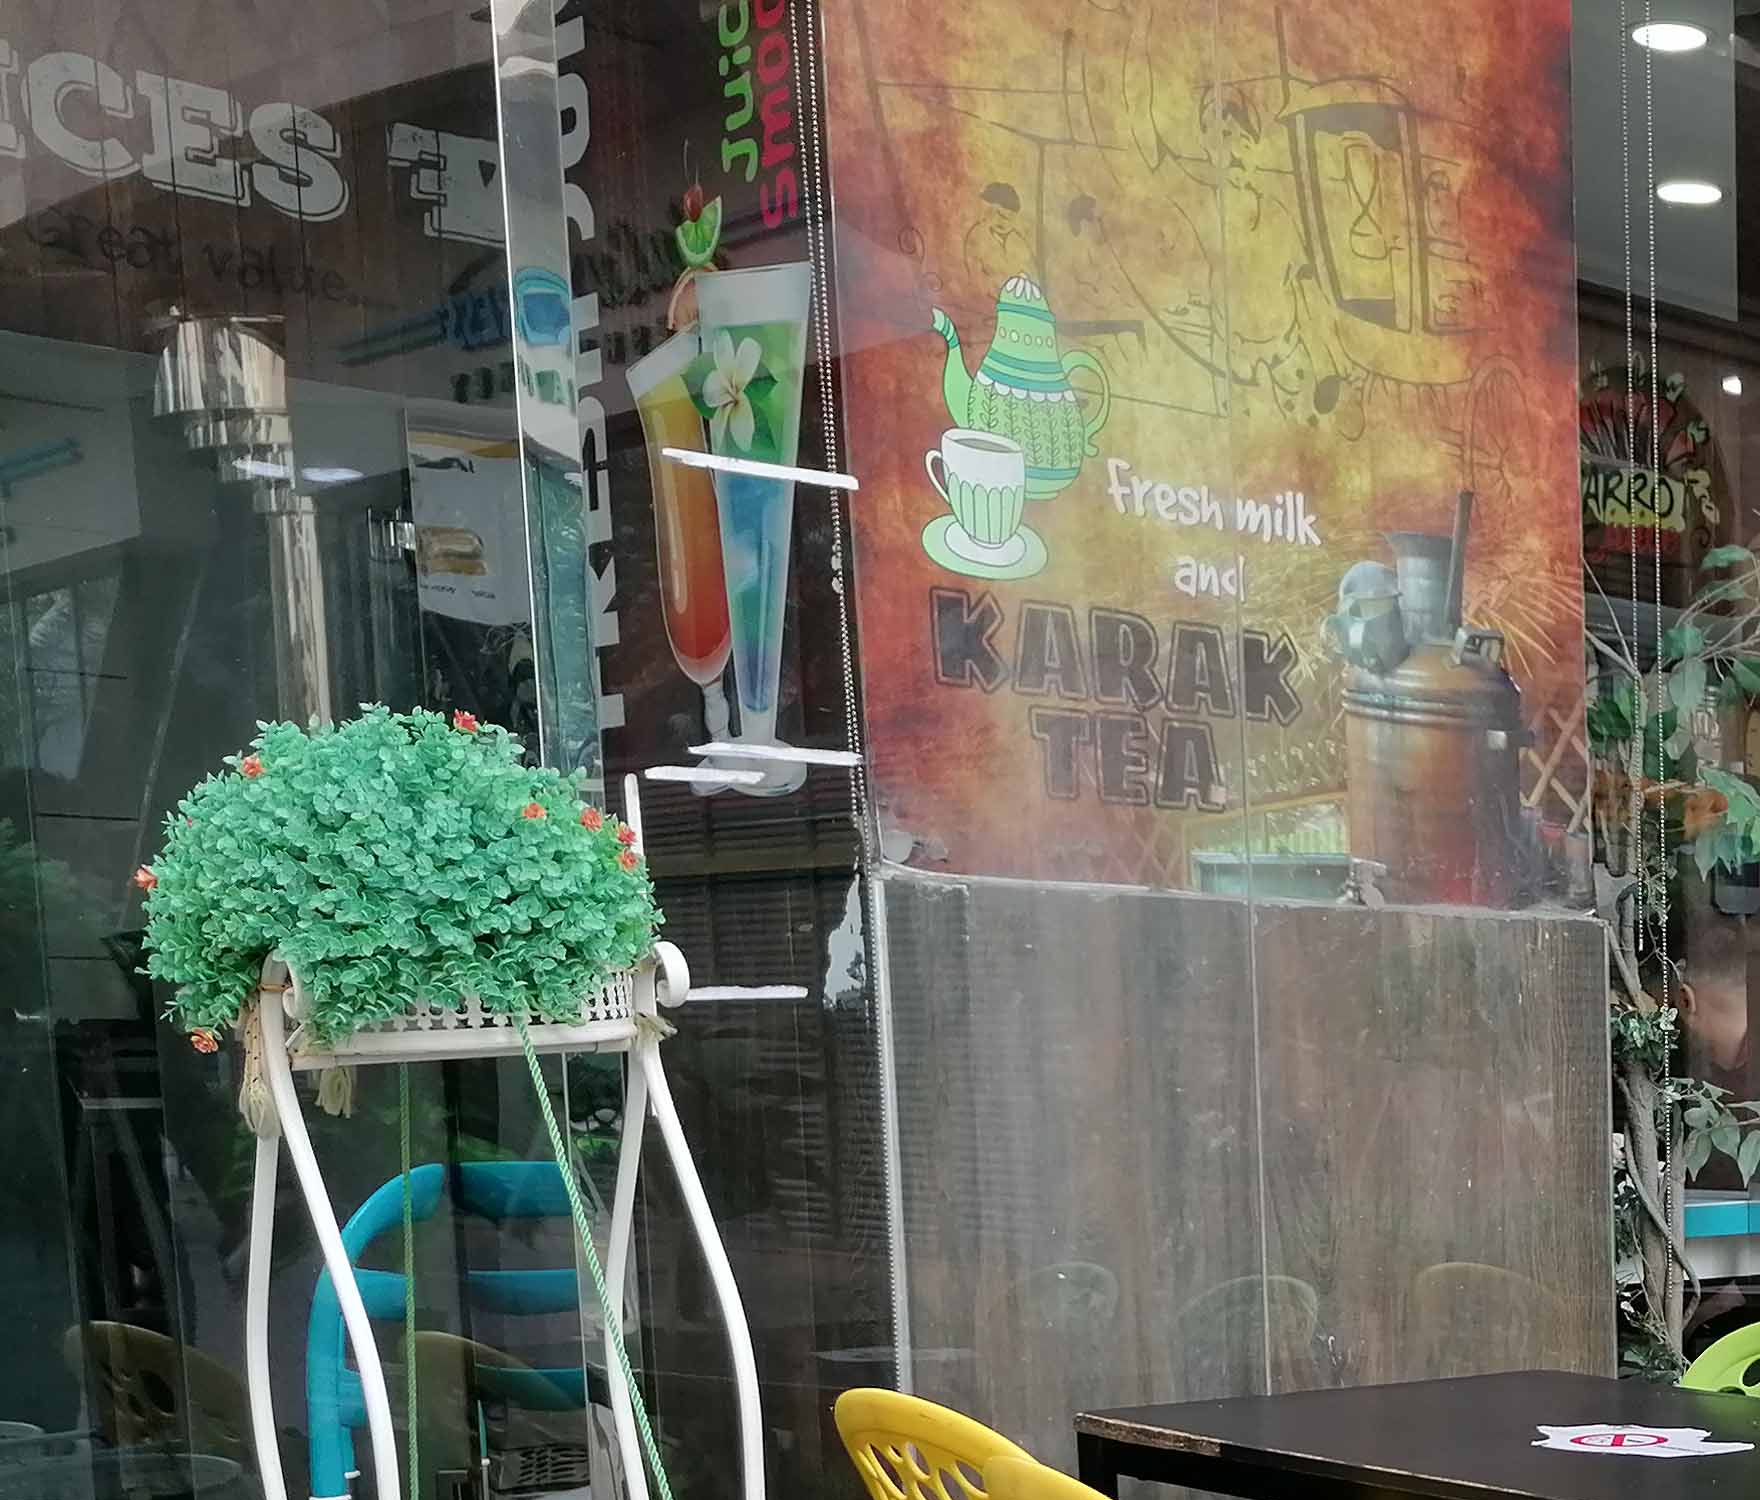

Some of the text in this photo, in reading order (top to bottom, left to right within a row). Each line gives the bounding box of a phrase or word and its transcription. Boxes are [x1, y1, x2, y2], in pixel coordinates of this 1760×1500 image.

[1235, 491, 1322, 546] milk
[1174, 554, 1247, 603] and
[930, 586, 1303, 726] KARAK
[1028, 704, 1226, 812] TEA
